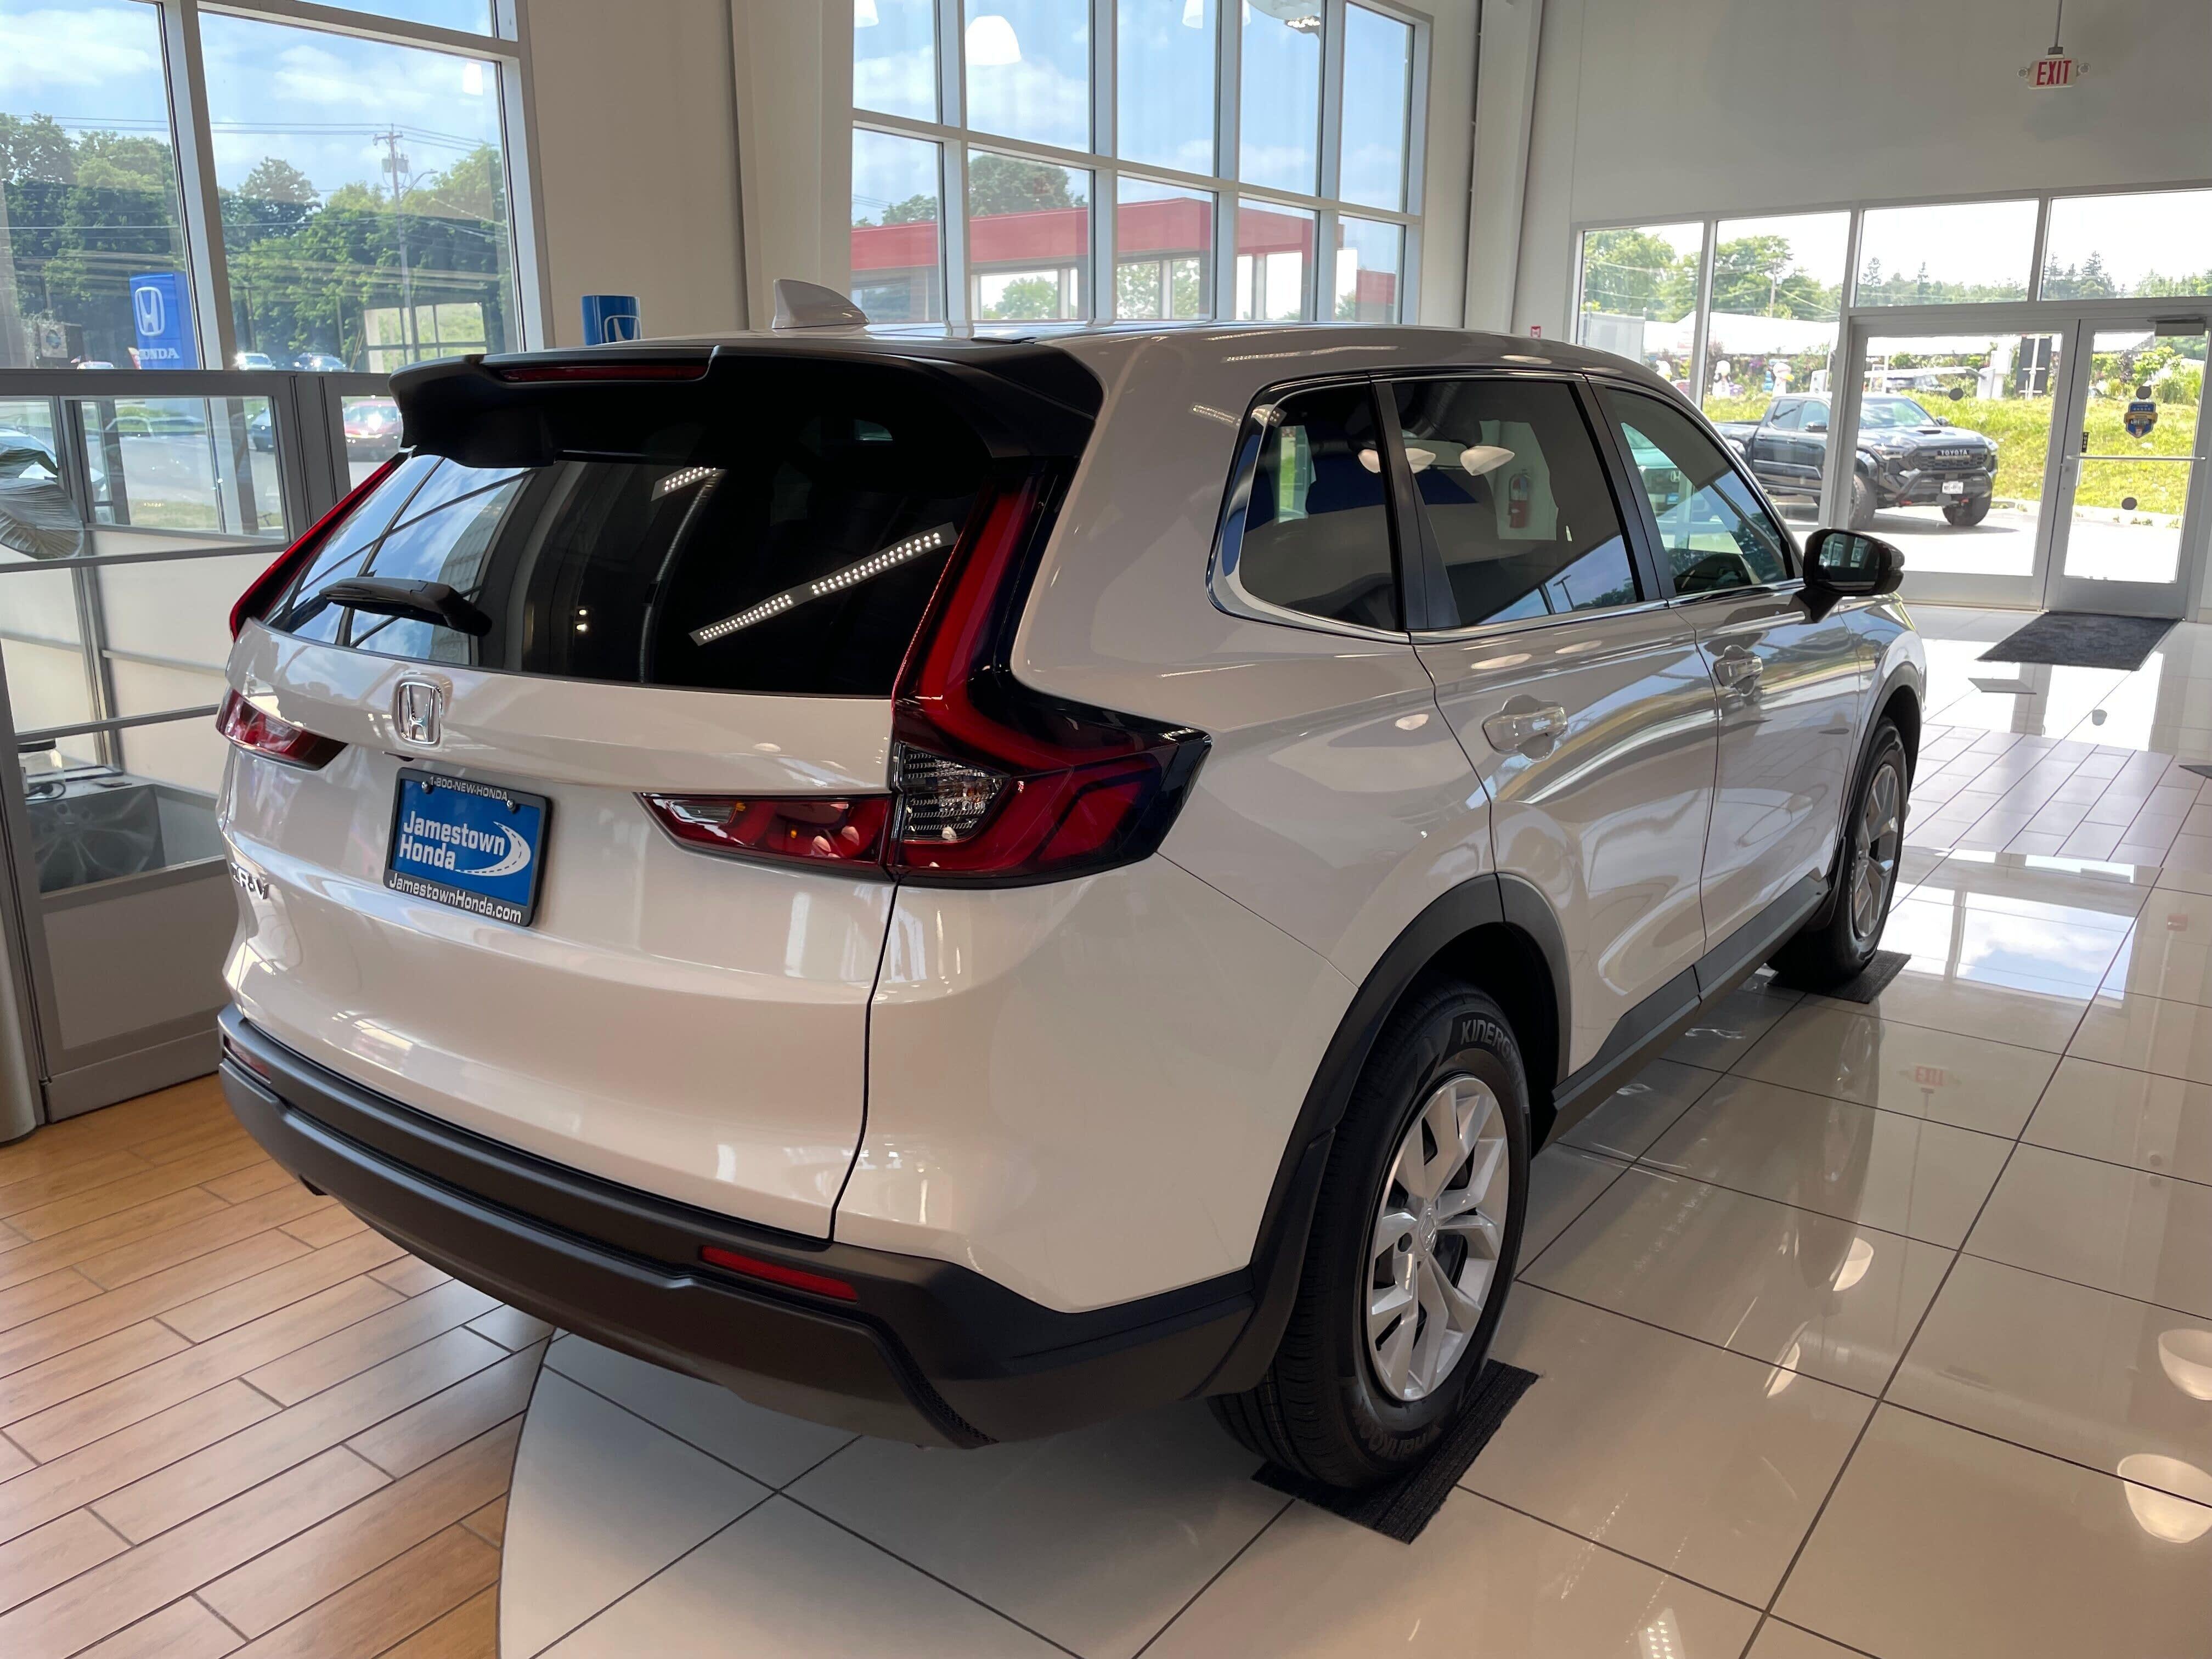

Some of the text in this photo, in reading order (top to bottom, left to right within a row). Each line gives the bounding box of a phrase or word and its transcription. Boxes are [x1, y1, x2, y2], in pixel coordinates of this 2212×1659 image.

[2036, 60, 2072, 85] EXIT
[138, 348, 180, 360] ONDA
[429, 776, 509, 802] 1-800-NEW-HONDA
[403, 811, 505, 856] Jamestown
[399, 834, 456, 871] Honda
[389, 873, 522, 923] JamestownHonda.com
